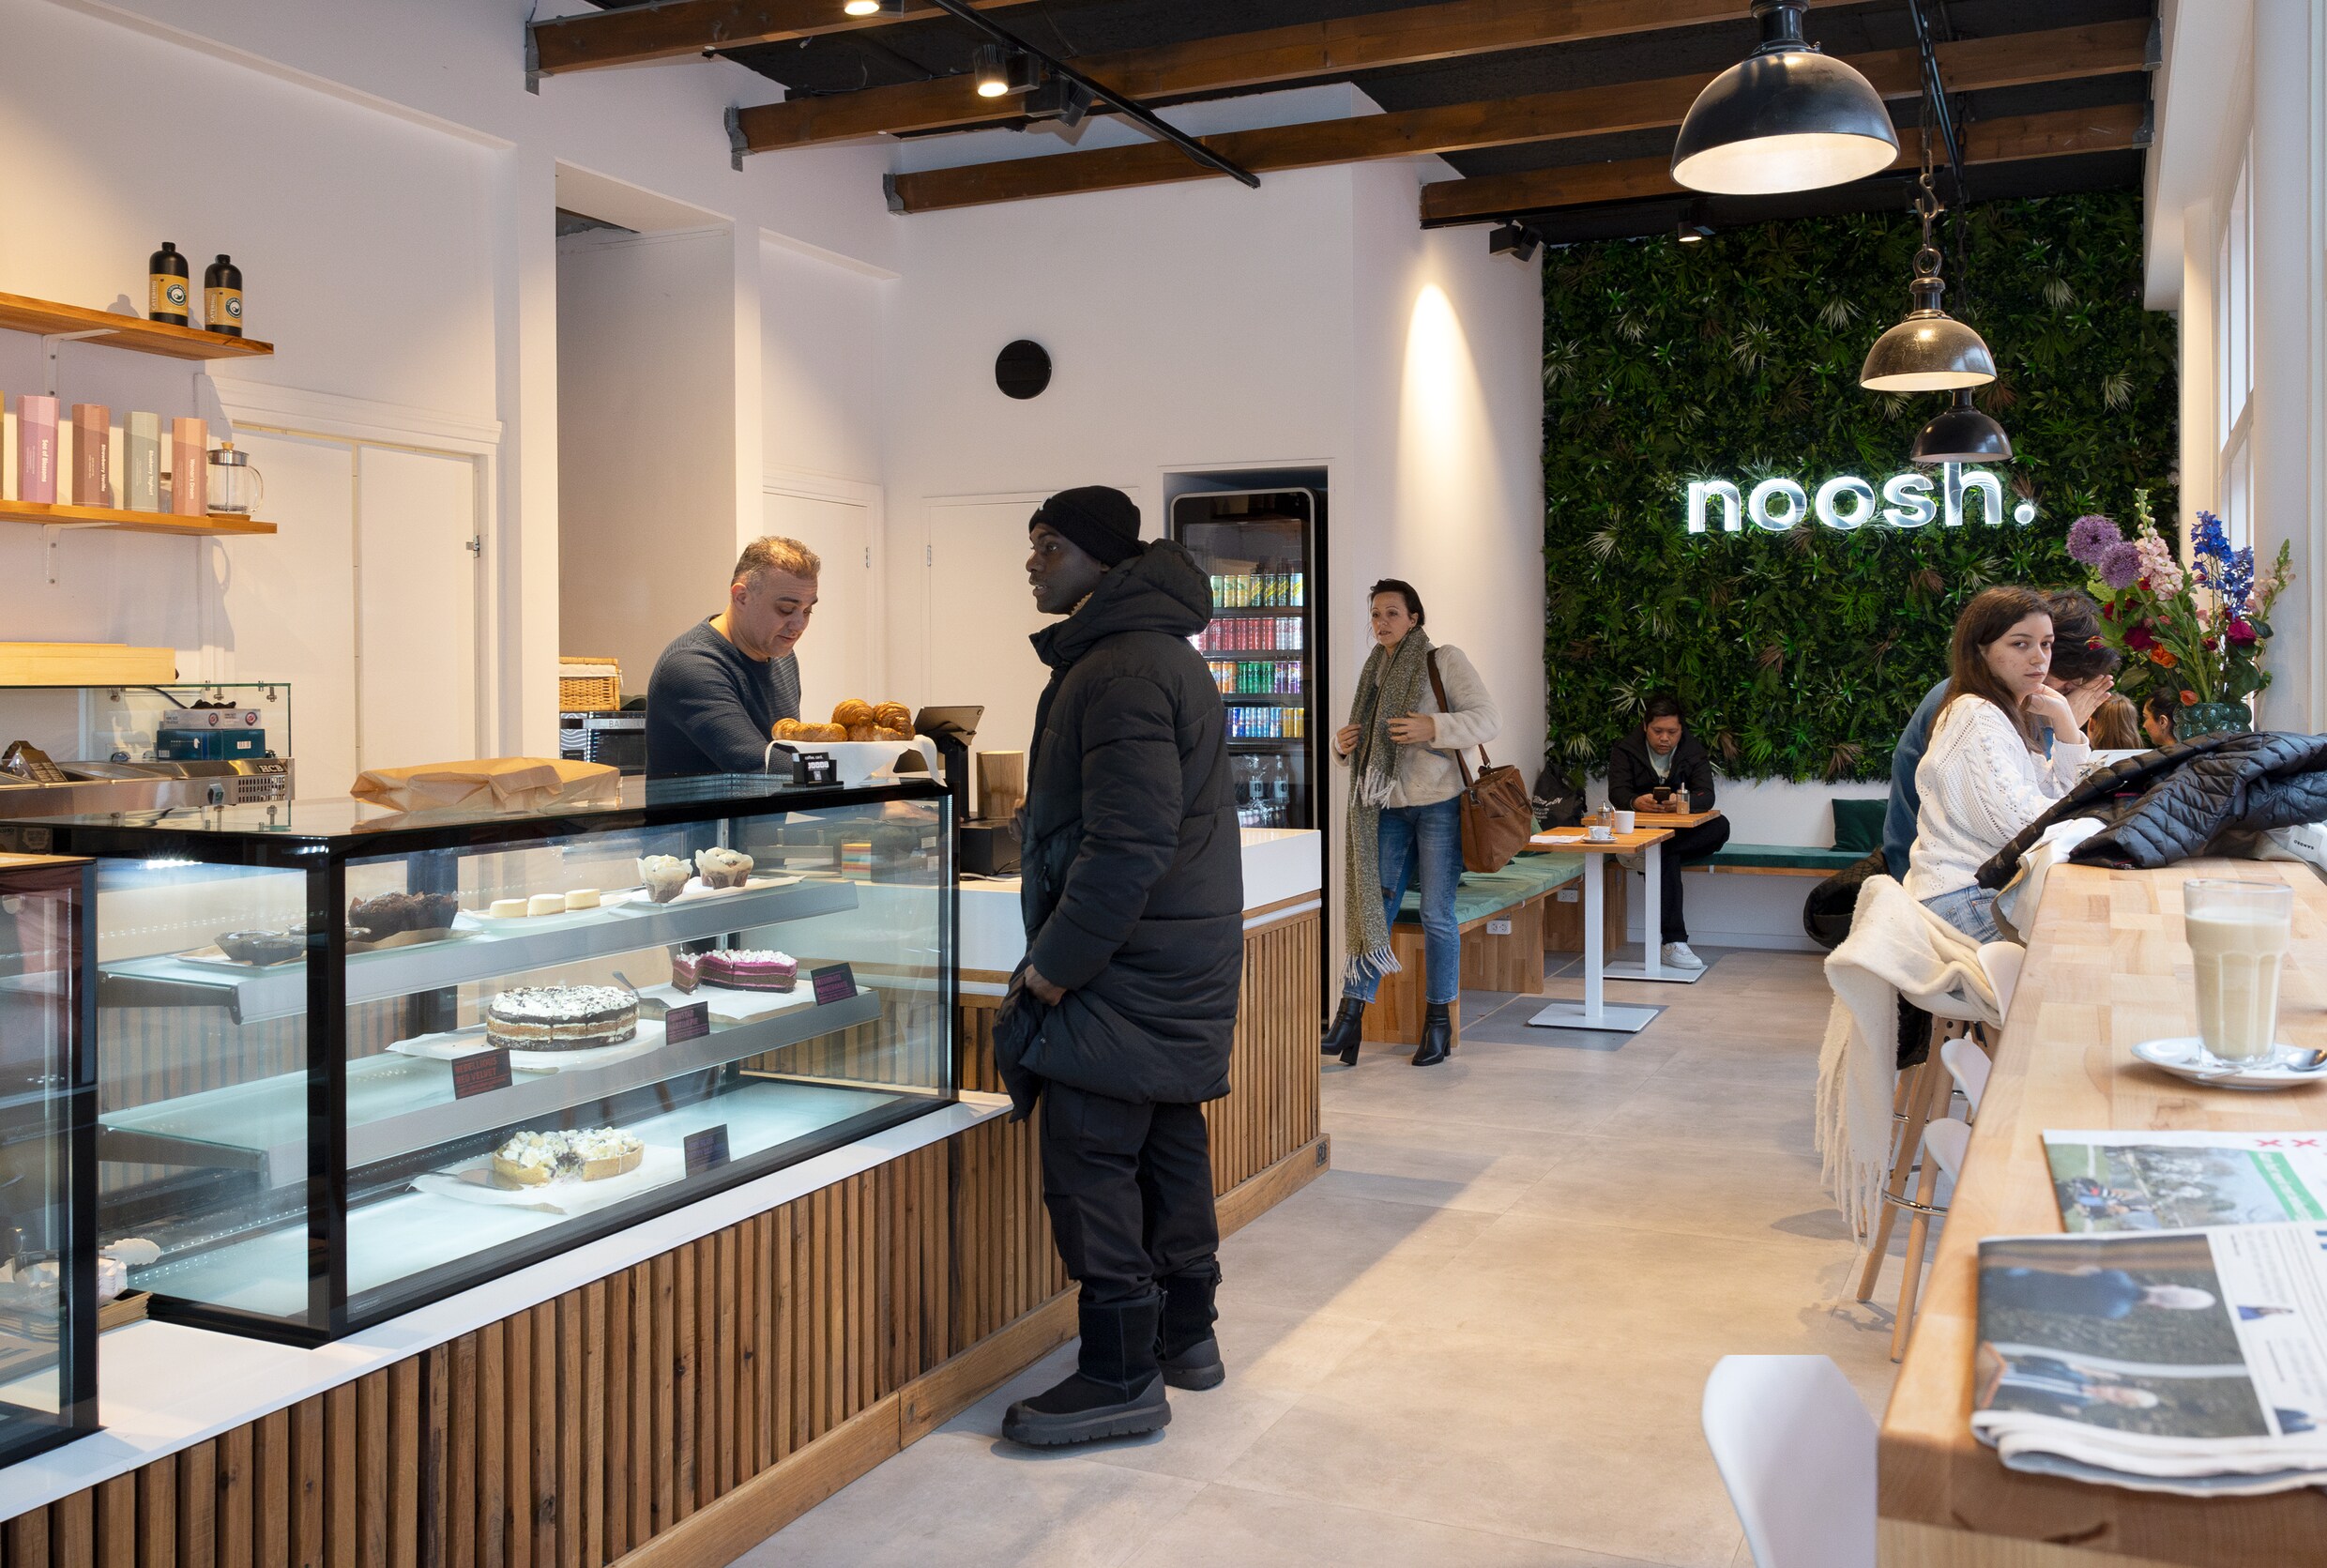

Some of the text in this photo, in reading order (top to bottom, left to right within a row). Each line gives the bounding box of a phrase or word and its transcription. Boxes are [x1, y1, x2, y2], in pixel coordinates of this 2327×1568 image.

[1688, 462, 2035, 532] noosh.
[455, 1068, 496, 1084] RED VELVET
